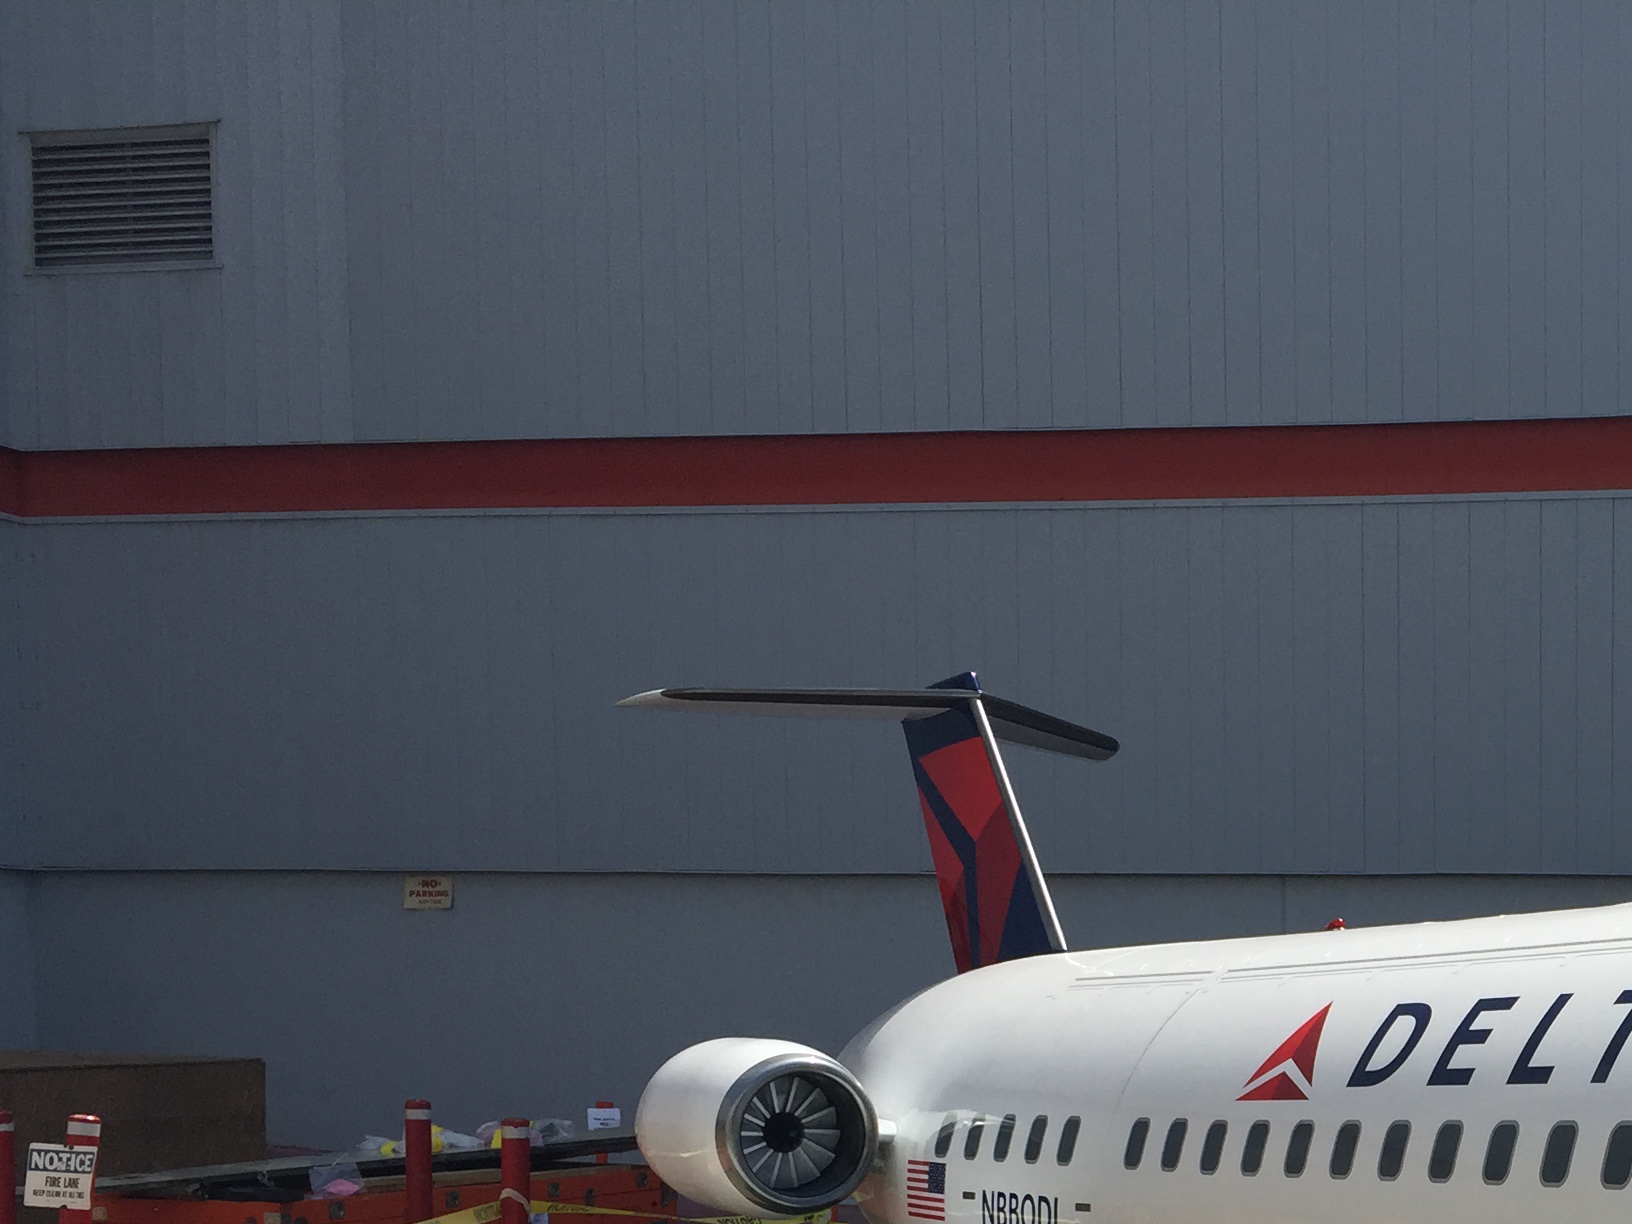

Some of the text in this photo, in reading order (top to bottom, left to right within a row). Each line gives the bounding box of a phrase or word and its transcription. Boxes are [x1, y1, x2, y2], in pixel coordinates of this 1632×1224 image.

[31, 1151, 93, 1172] NOTICE
[45, 1176, 80, 1189] FIRE LANE
